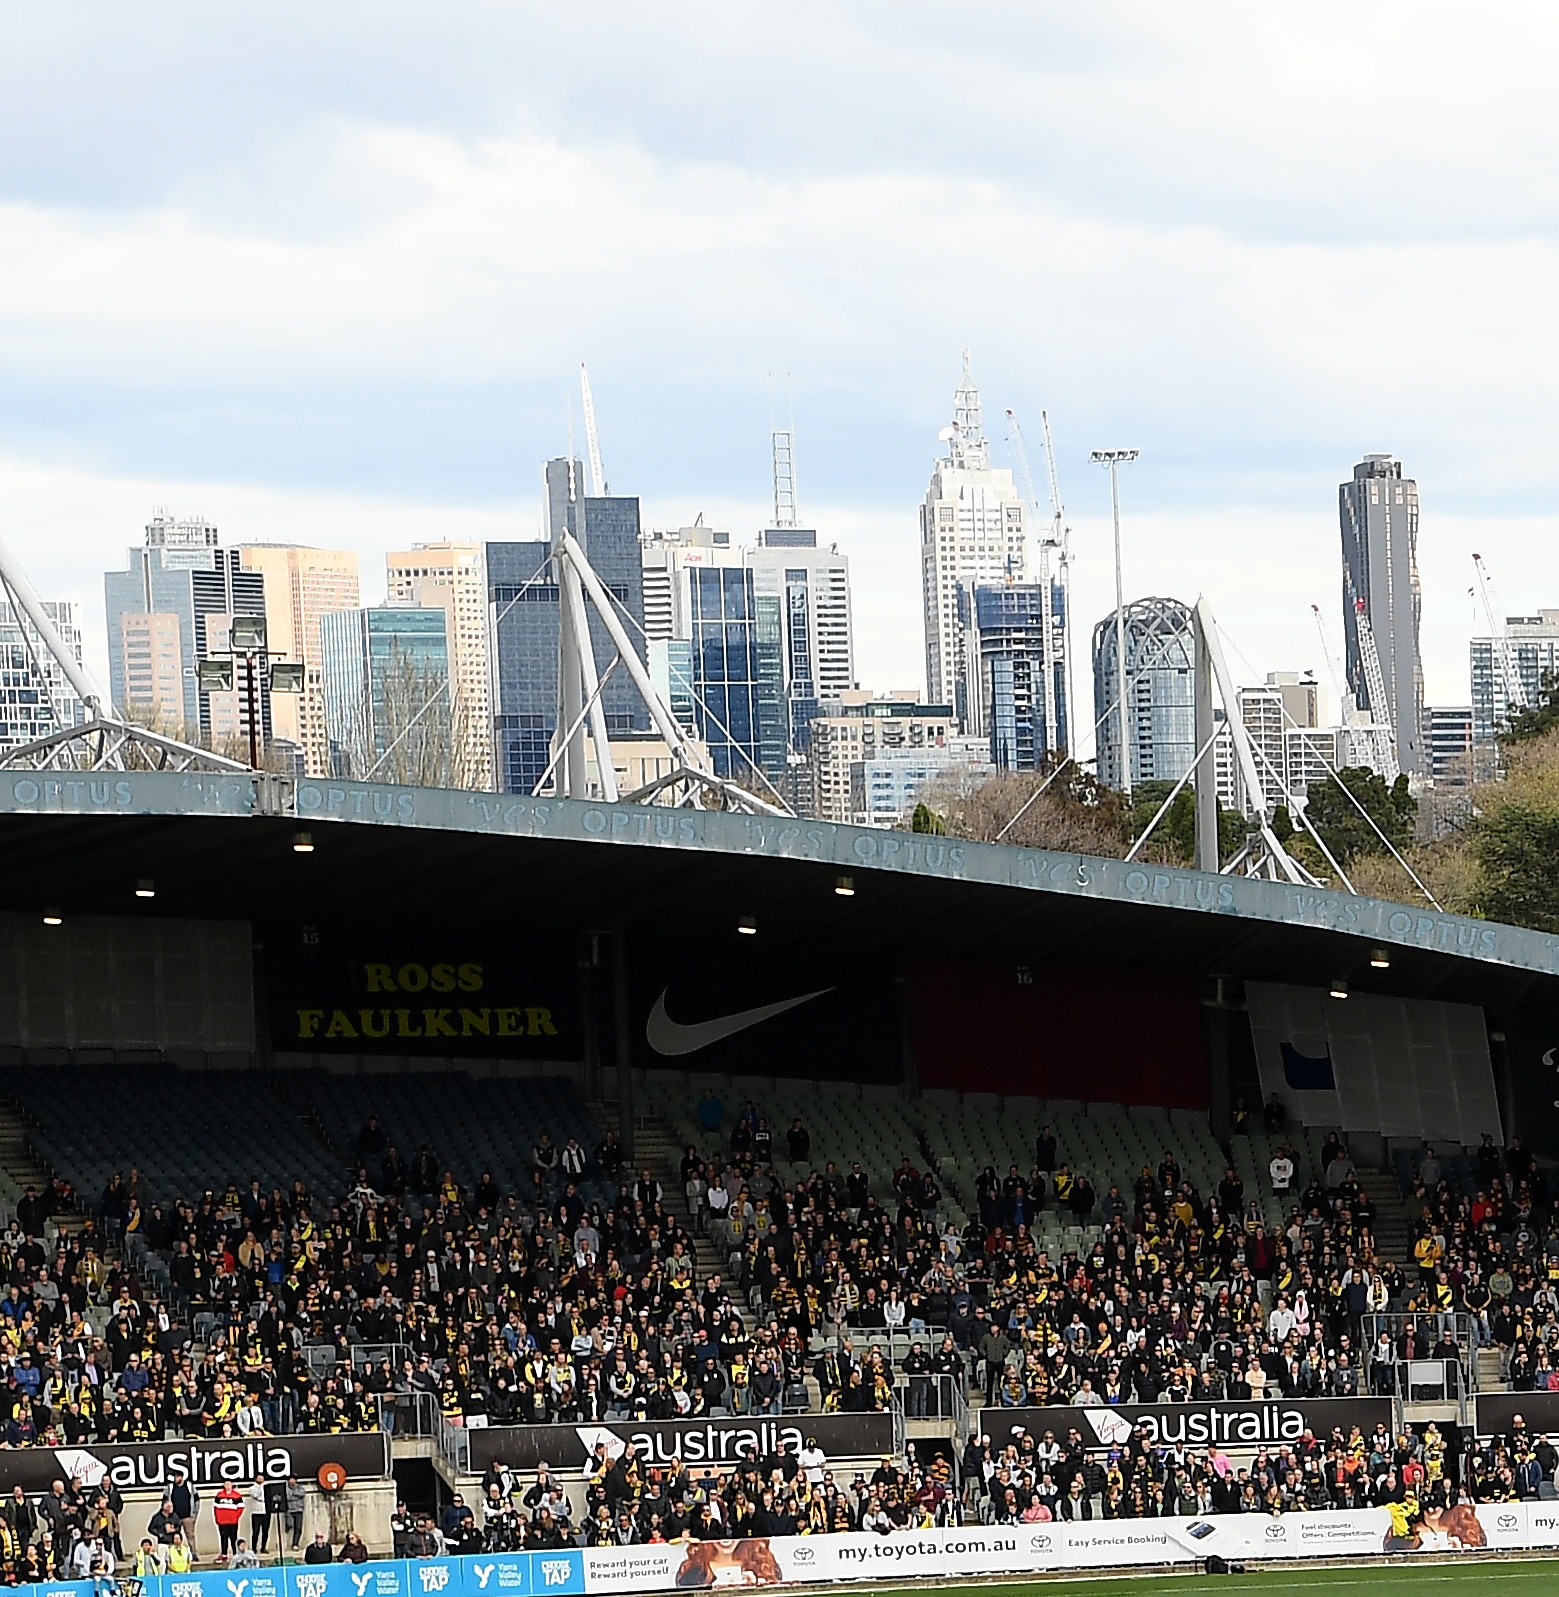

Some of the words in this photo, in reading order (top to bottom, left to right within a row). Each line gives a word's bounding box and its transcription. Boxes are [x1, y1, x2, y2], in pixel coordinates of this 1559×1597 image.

[13, 779, 132, 806] OPTUS
[299, 786, 414, 818] OPTUS
[582, 809, 695, 839] OPTUS
[853, 834, 966, 872] OPTUS
[1124, 870, 1234, 907] OPTUS
[1388, 912, 1497, 952] OPTUS
[365, 963, 483, 992] ROSS
[297, 1007, 558, 1038] FAULKNER
[630, 1422, 804, 1461] australia
[110, 1443, 292, 1486] australia
[590, 1560, 626, 1569] Reward
[628, 1558, 651, 1568] your
[653, 1557, 668, 1565] car
[838, 1538, 1016, 1562] my.toyota.com.au
[591, 1570, 627, 1579] Reward
[629, 1567, 669, 1579] yourself
